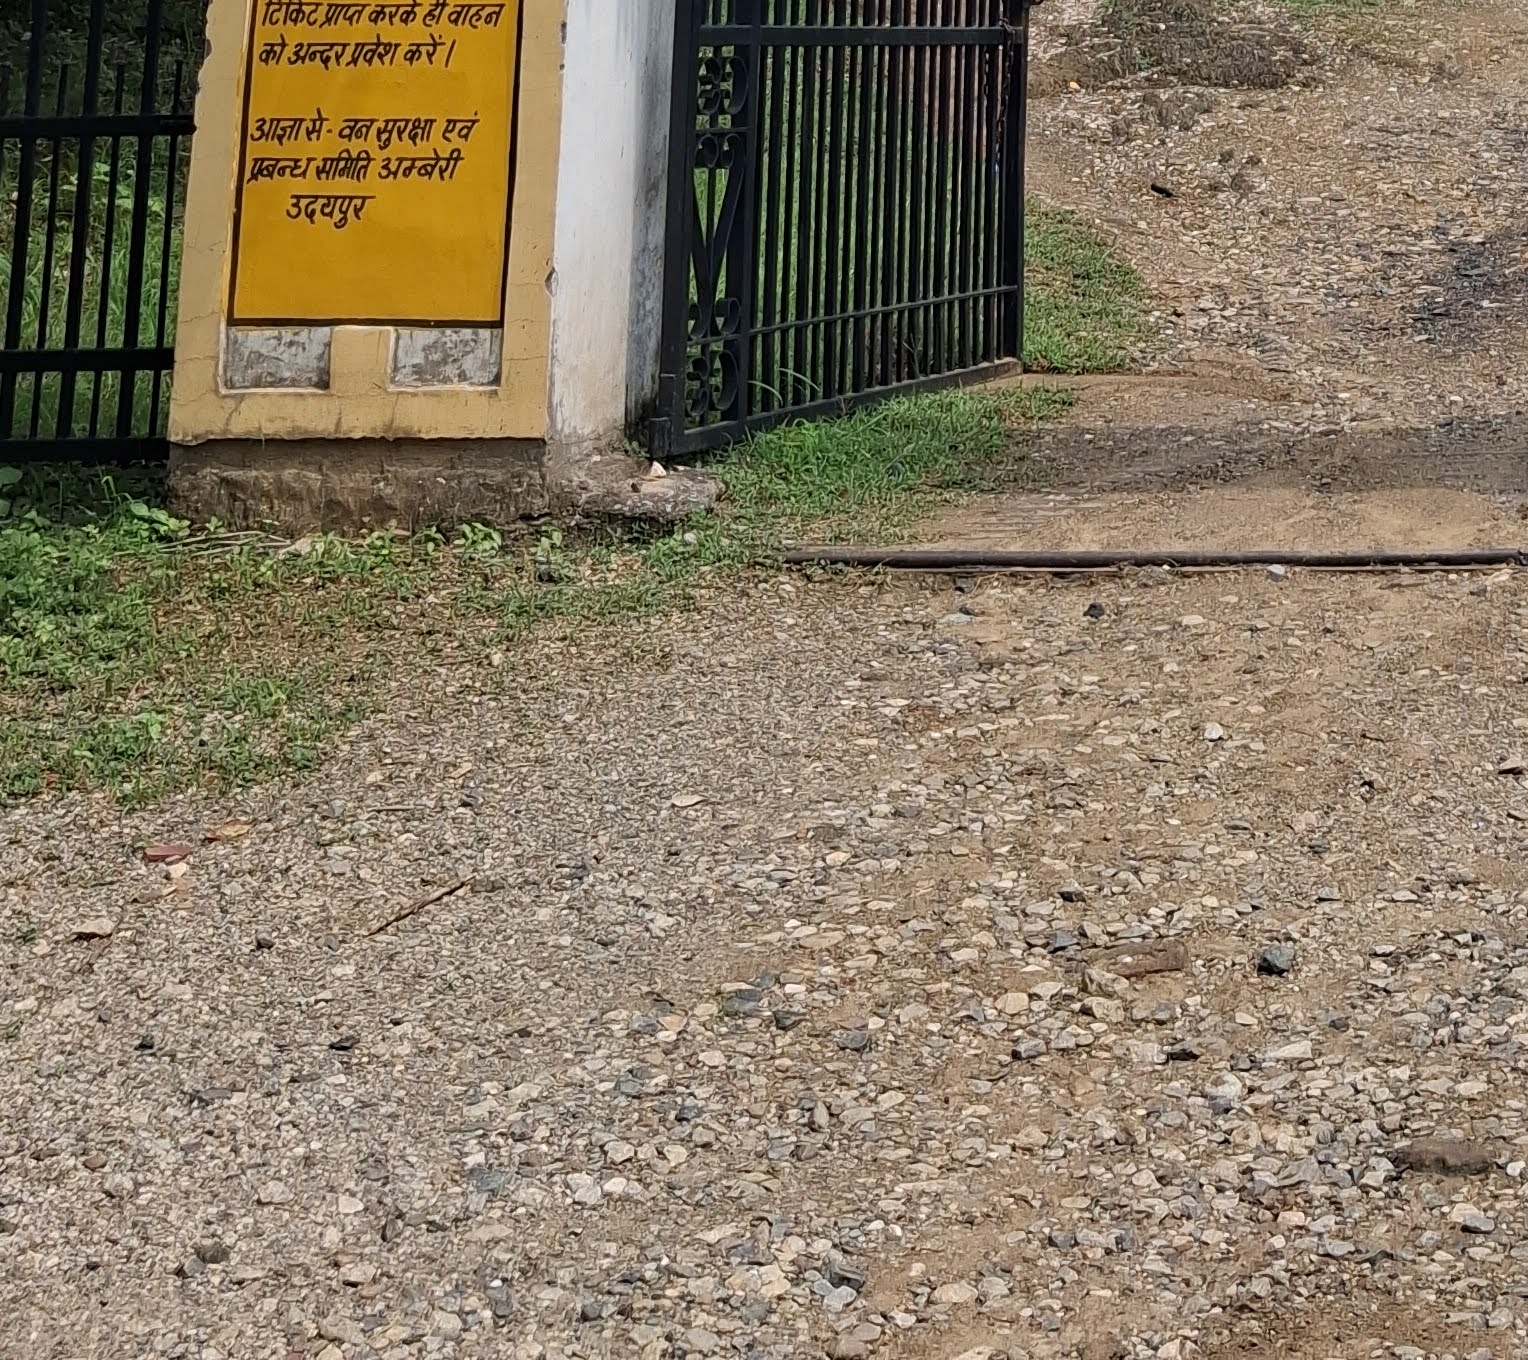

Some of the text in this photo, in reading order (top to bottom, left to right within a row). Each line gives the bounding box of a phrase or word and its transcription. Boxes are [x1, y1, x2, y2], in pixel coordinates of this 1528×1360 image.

[319, 3, 371, 28] प्राप्त
[447, 3, 505, 28] वाहन
[259, 33, 402, 70] को अन्दर प्रवेश
[250, 111, 480, 150] आज्ञा वन सुरक्षा एवं
[246, 148, 464, 184] प्रबन्ध समिति अम्बेरी
[286, 194, 376, 230] उदयपुर
